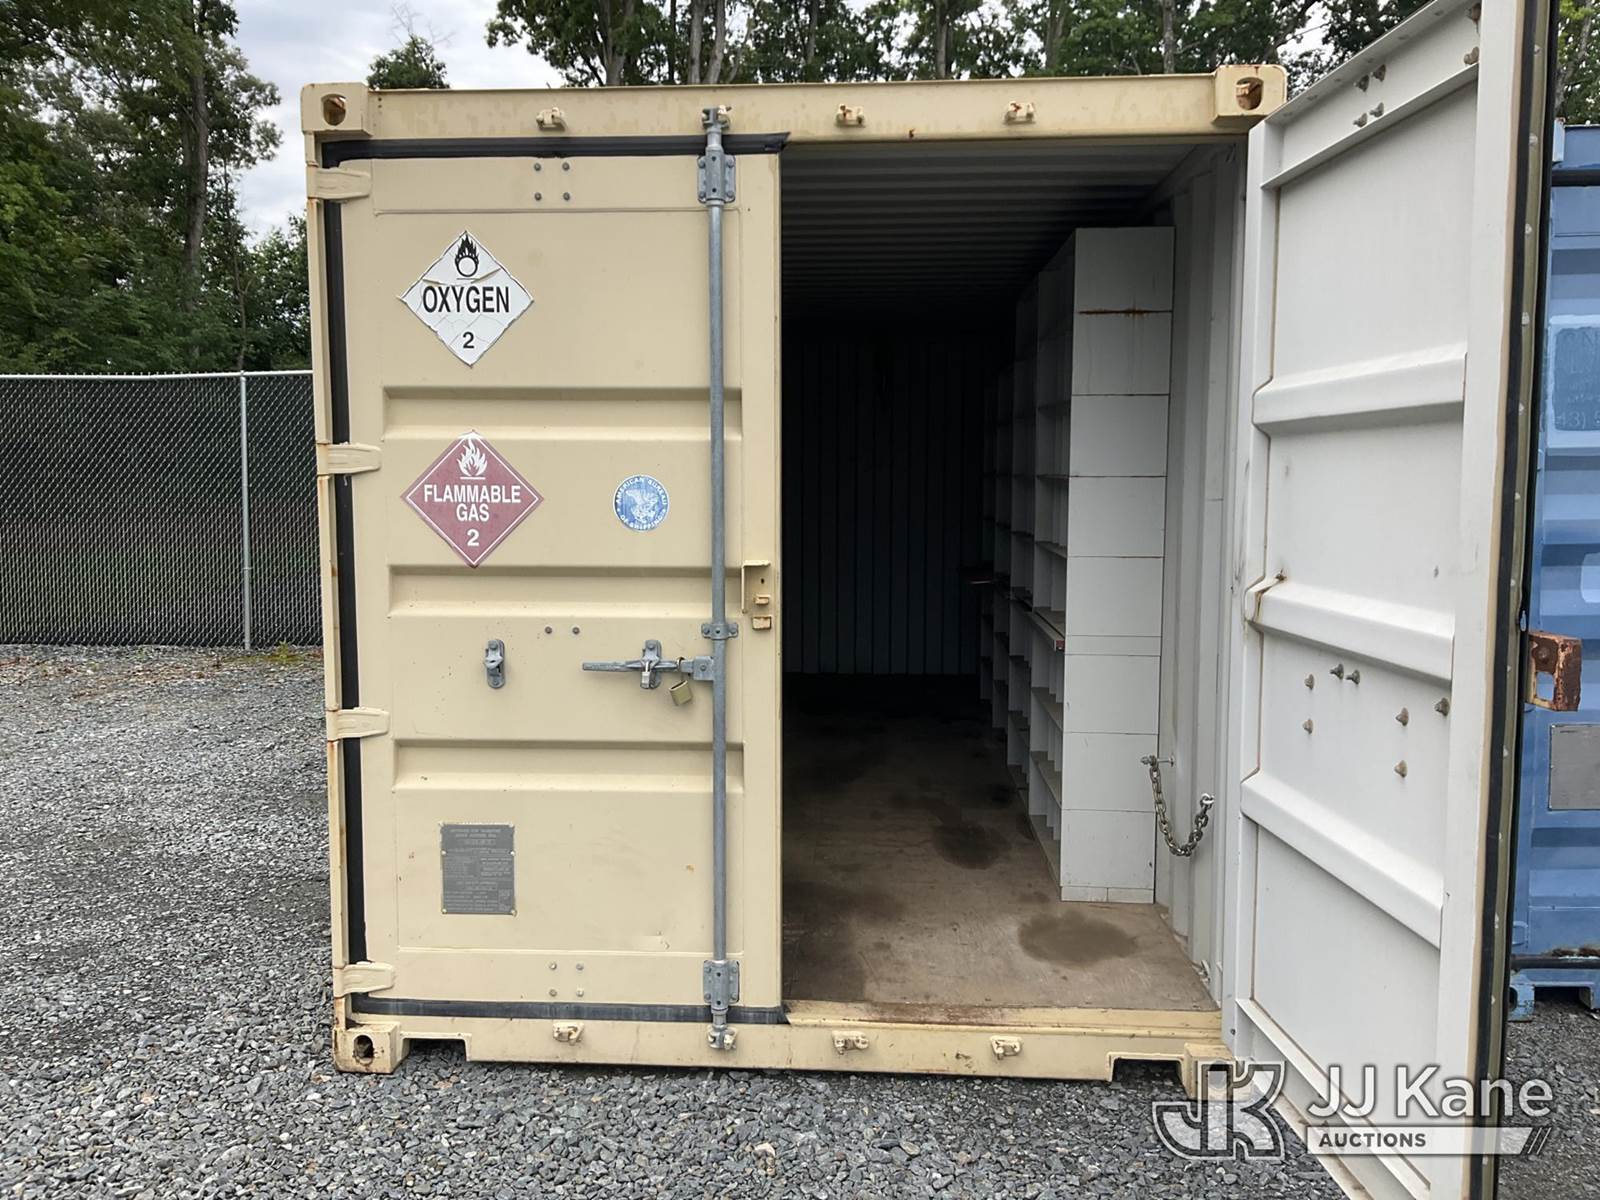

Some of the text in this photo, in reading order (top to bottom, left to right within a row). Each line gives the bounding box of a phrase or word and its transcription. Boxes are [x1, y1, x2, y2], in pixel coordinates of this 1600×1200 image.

[422, 285, 510, 313] OXYGEN
[462, 331, 475, 349] 2
[424, 484, 522, 503] FLAMMABLE
[456, 502, 490, 522] GAS
[467, 528, 480, 546] 2
